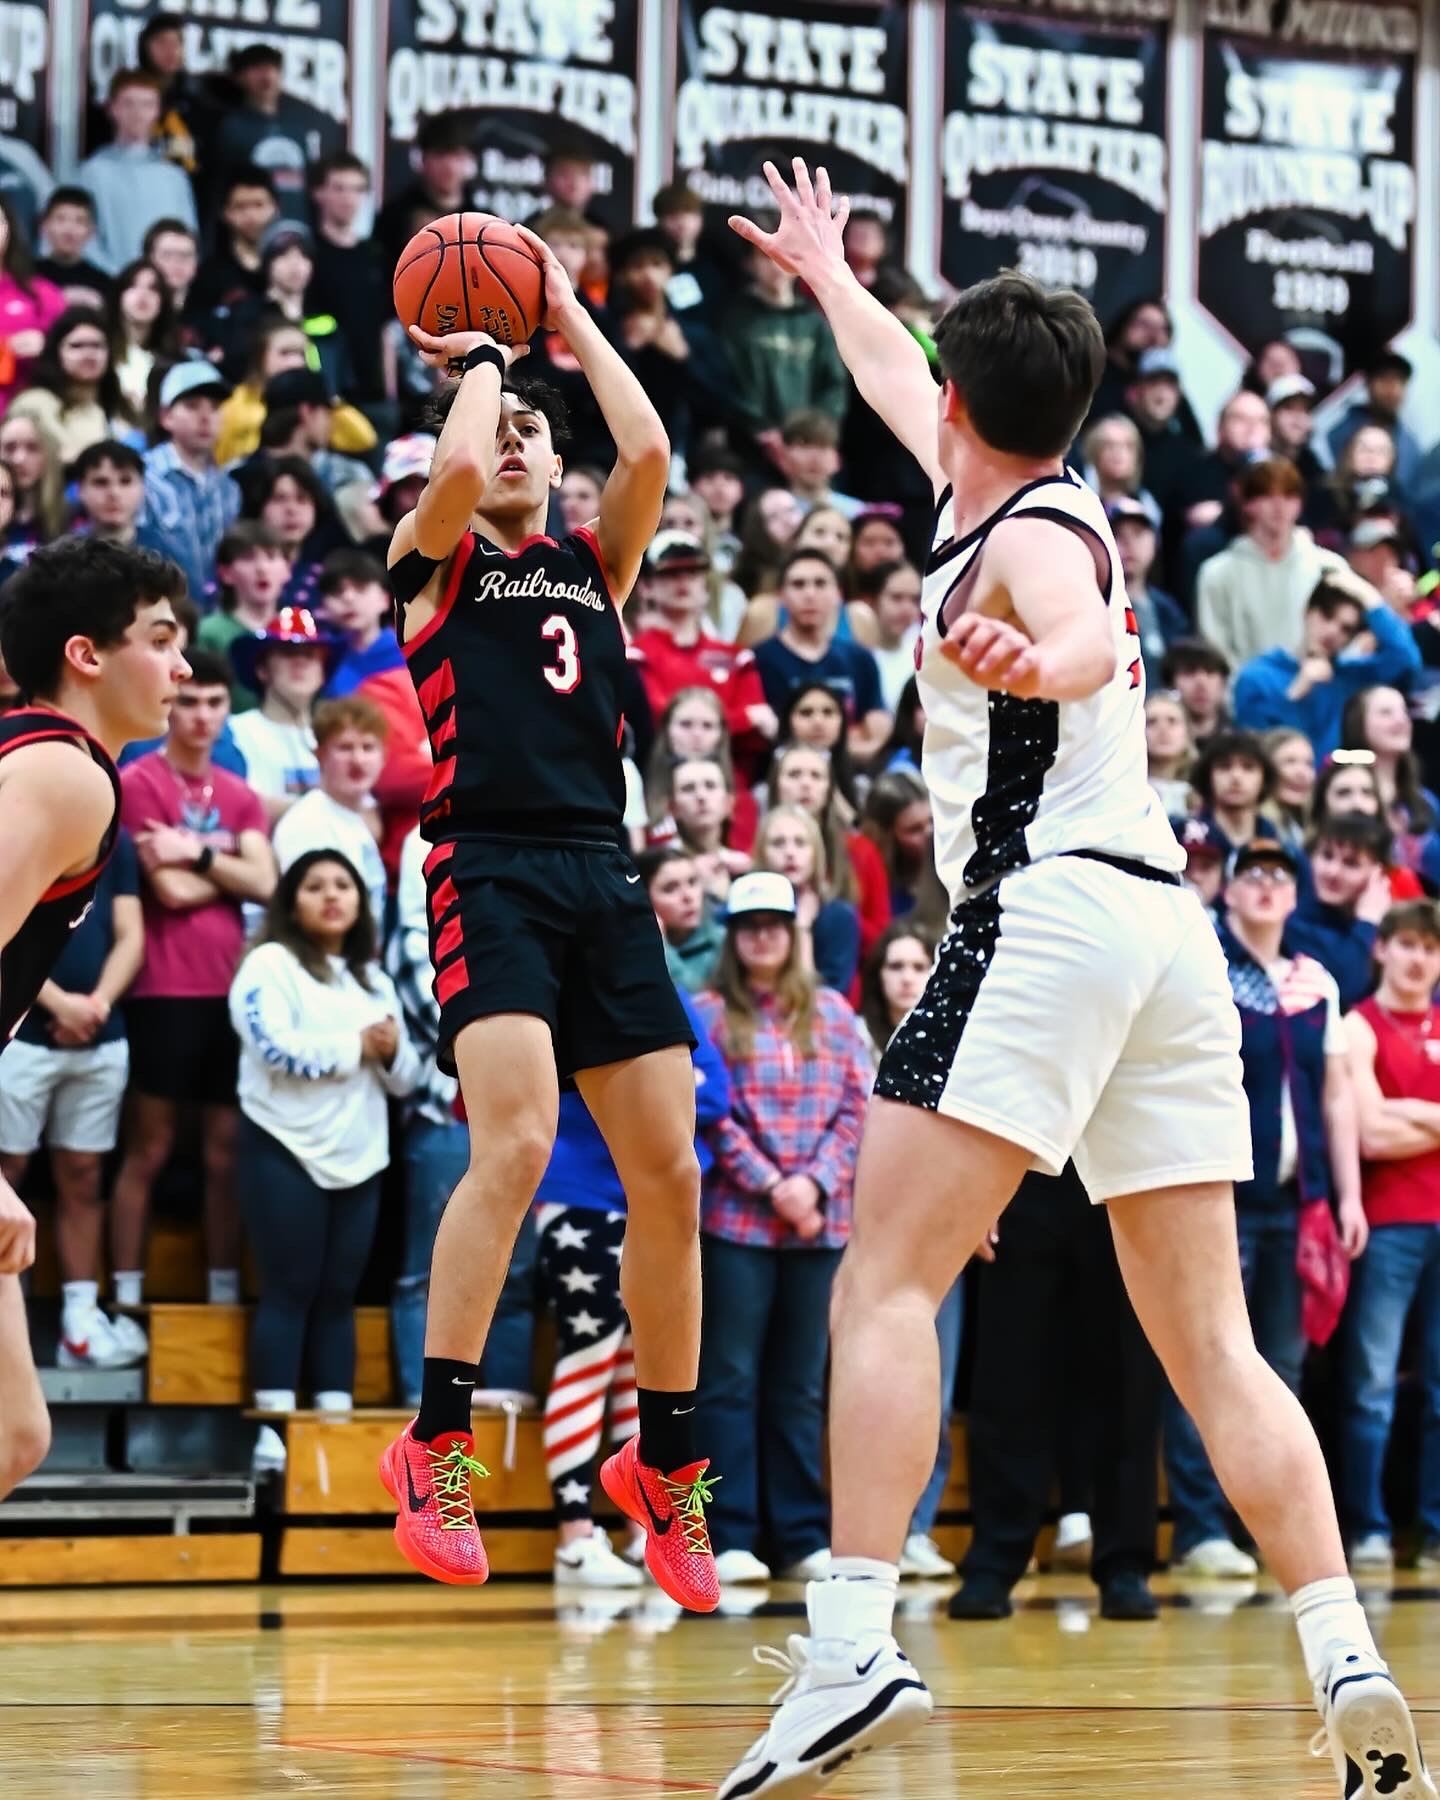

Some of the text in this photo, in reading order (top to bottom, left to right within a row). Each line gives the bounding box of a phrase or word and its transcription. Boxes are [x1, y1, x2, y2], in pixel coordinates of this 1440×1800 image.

[415, 0, 614, 63] STATE
[700, 7, 887, 95] STATE
[388, 46, 637, 157] QUALIFIER
[967, 40, 1144, 125] STATE
[1223, 72, 1396, 155] STATE
[677, 78, 908, 184] QUALIFIER
[943, 109, 1167, 214] QUALIFIER
[1200, 138, 1416, 252] RUNNER-UP
[1245, 228, 1374, 274] Football
[475, 567, 605, 612] Railroaders
[541, 614, 581, 694] 3
